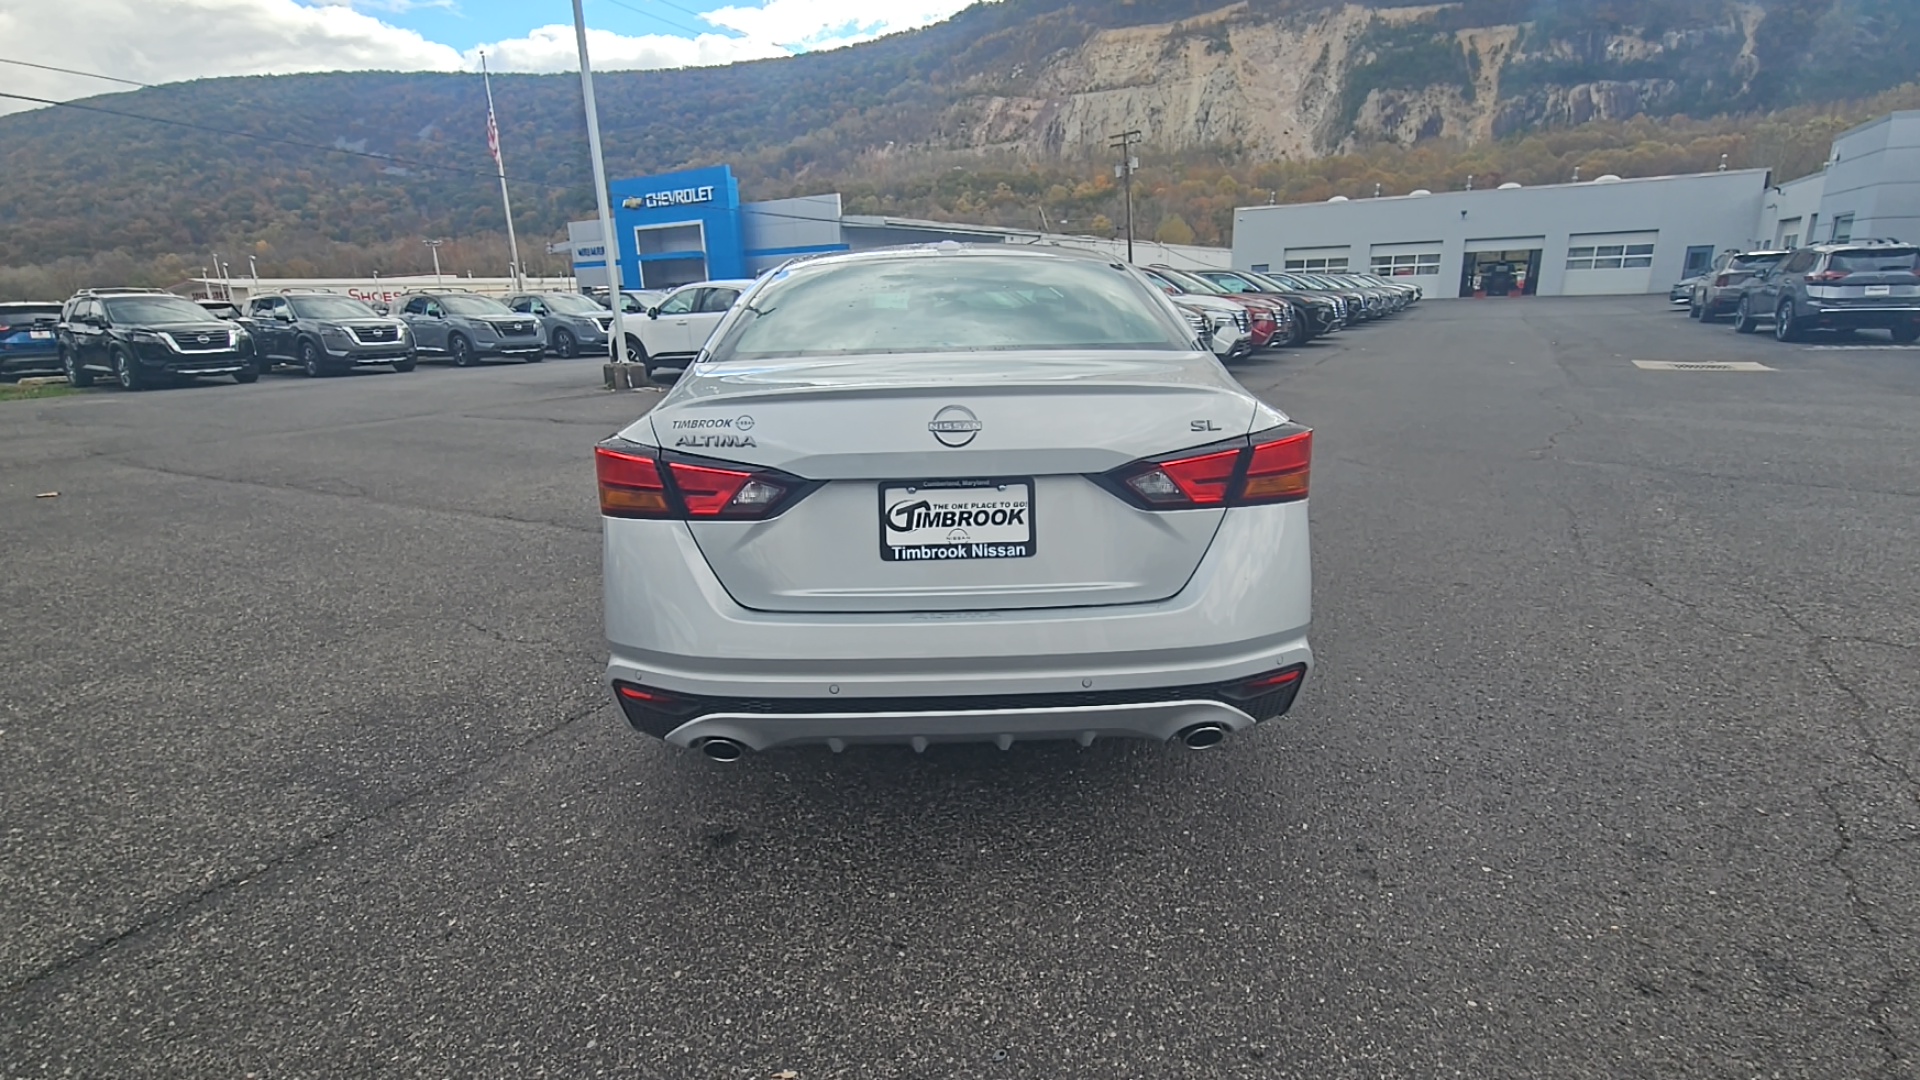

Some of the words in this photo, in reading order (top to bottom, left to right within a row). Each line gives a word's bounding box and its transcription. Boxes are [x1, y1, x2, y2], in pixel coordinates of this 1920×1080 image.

[646, 186, 714, 208] CHEVROLET
[672, 419, 733, 429] TIMBROOK
[928, 421, 982, 431] NISSAN
[1191, 419, 1222, 432] SL
[675, 435, 757, 448] ALTIMA
[886, 499, 1026, 532] TIMBROOK
[892, 545, 967, 560] Timbrook
[972, 544, 1026, 557] Nissan
